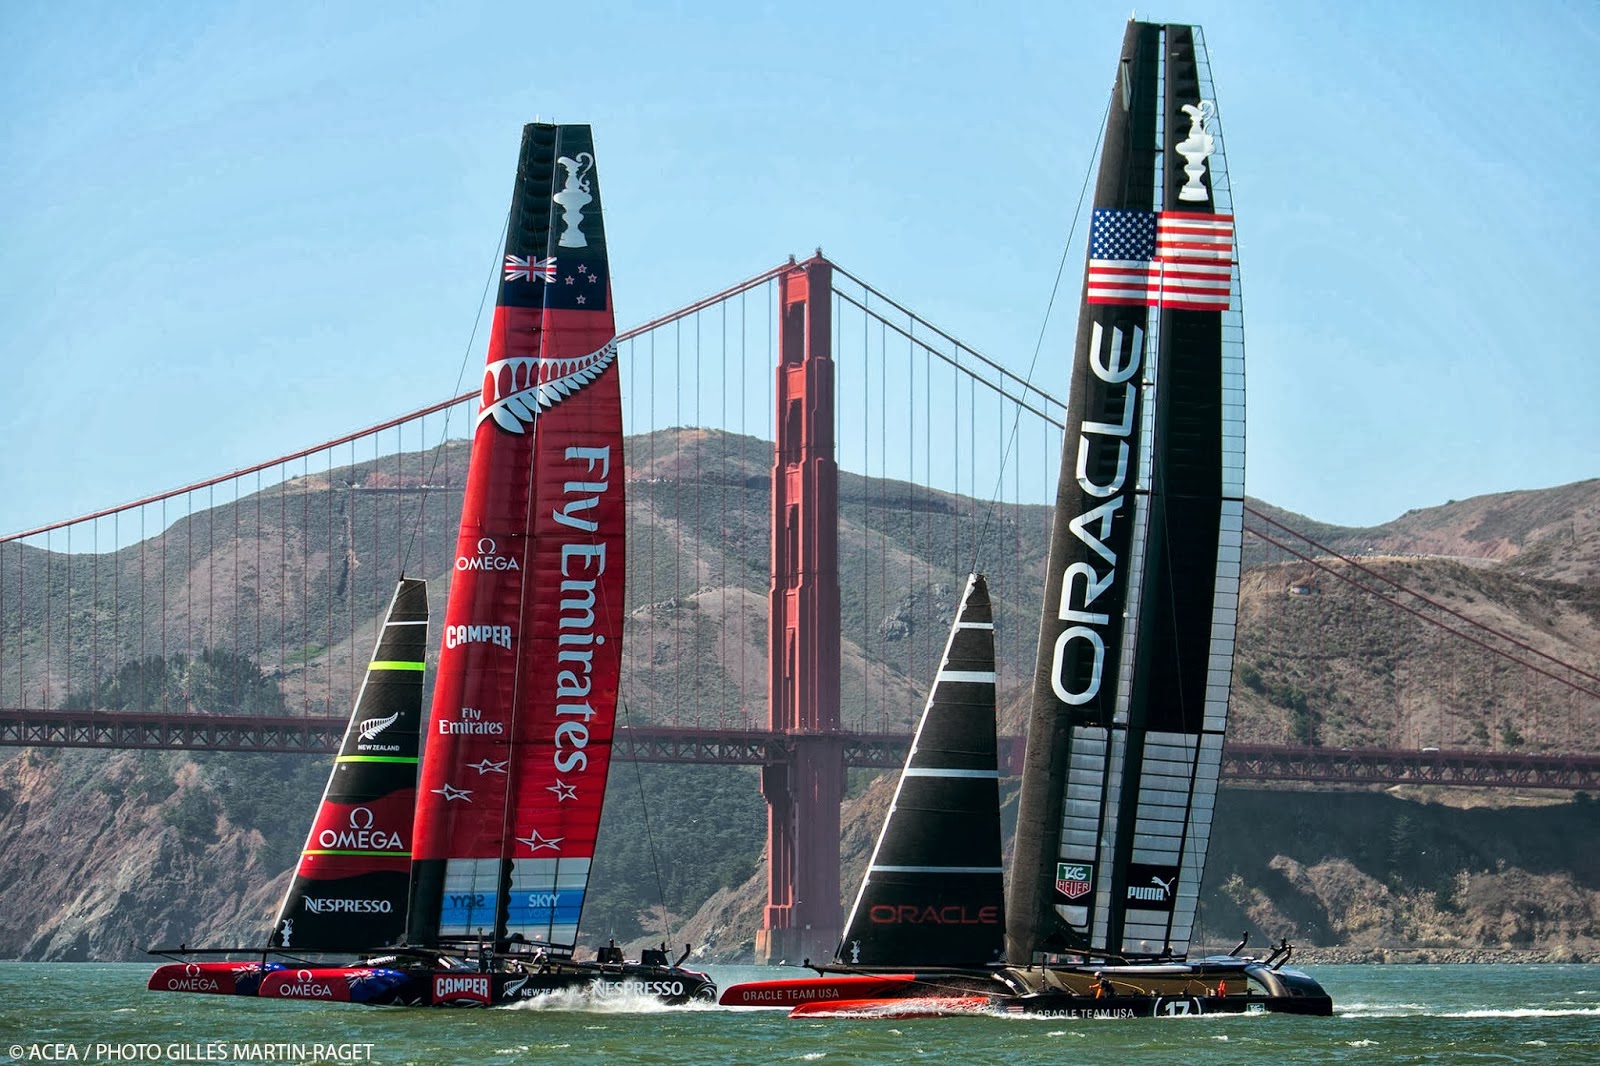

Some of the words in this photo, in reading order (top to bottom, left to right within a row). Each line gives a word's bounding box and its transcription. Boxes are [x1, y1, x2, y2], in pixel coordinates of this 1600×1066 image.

[553, 445, 610, 533] Fly
[1051, 320, 1144, 705] ORACLE
[456, 557, 519, 571] OMEGA
[446, 625, 511, 650] CAMPER
[554, 541, 607, 774] Emirates
[462, 708, 481, 720] Fly
[439, 719, 503, 735] Emirates
[319, 829, 403, 849] OMEGA
[1063, 866, 1086, 881] TAG
[1058, 881, 1089, 897] HEUER
[1127, 886, 1164, 901] PUMA
[303, 895, 391, 914] NESPRESSO
[529, 893, 560, 908] SKYY
[870, 905, 998, 924] ORACLE
[168, 978, 219, 991] OMEGA
[279, 984, 332, 996] OMEGA
[436, 977, 488, 999] CAMPER
[521, 988, 540, 997] NEW
[591, 979, 684, 998] NESPRESSO
[743, 990, 784, 1000] ORACLE
[785, 989, 816, 1000] TEAM
[818, 988, 839, 998] USA
[1081, 1009, 1110, 1018] TEAM
[1113, 1009, 1135, 1018] USA
